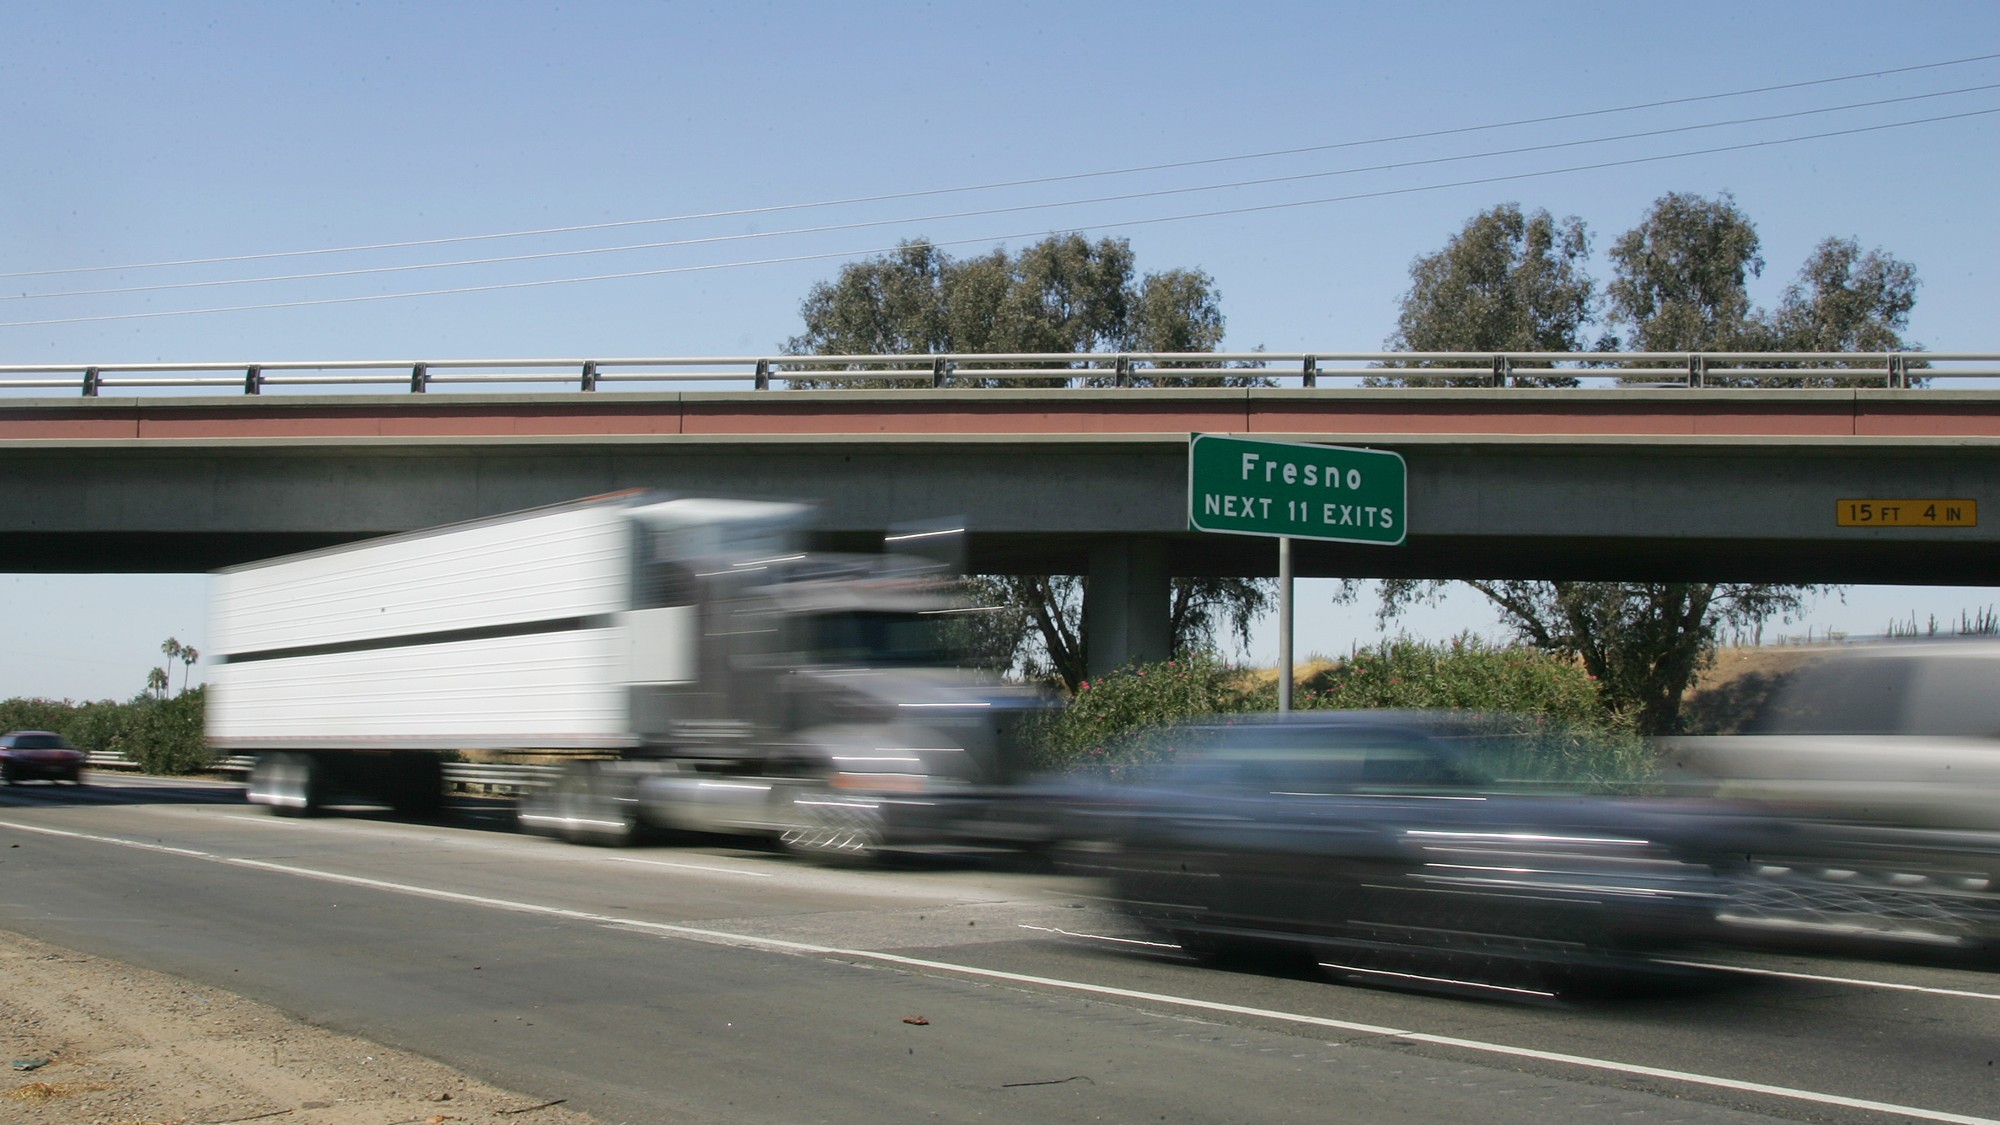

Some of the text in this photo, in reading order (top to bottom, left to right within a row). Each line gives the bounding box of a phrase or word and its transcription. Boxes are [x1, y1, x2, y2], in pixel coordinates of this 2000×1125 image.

[1242, 453, 1361, 490] Fresno
[1205, 494, 1394, 529] NEXT 11 EXITS
[1850, 504, 1961, 521] 15 FT 4 IN
